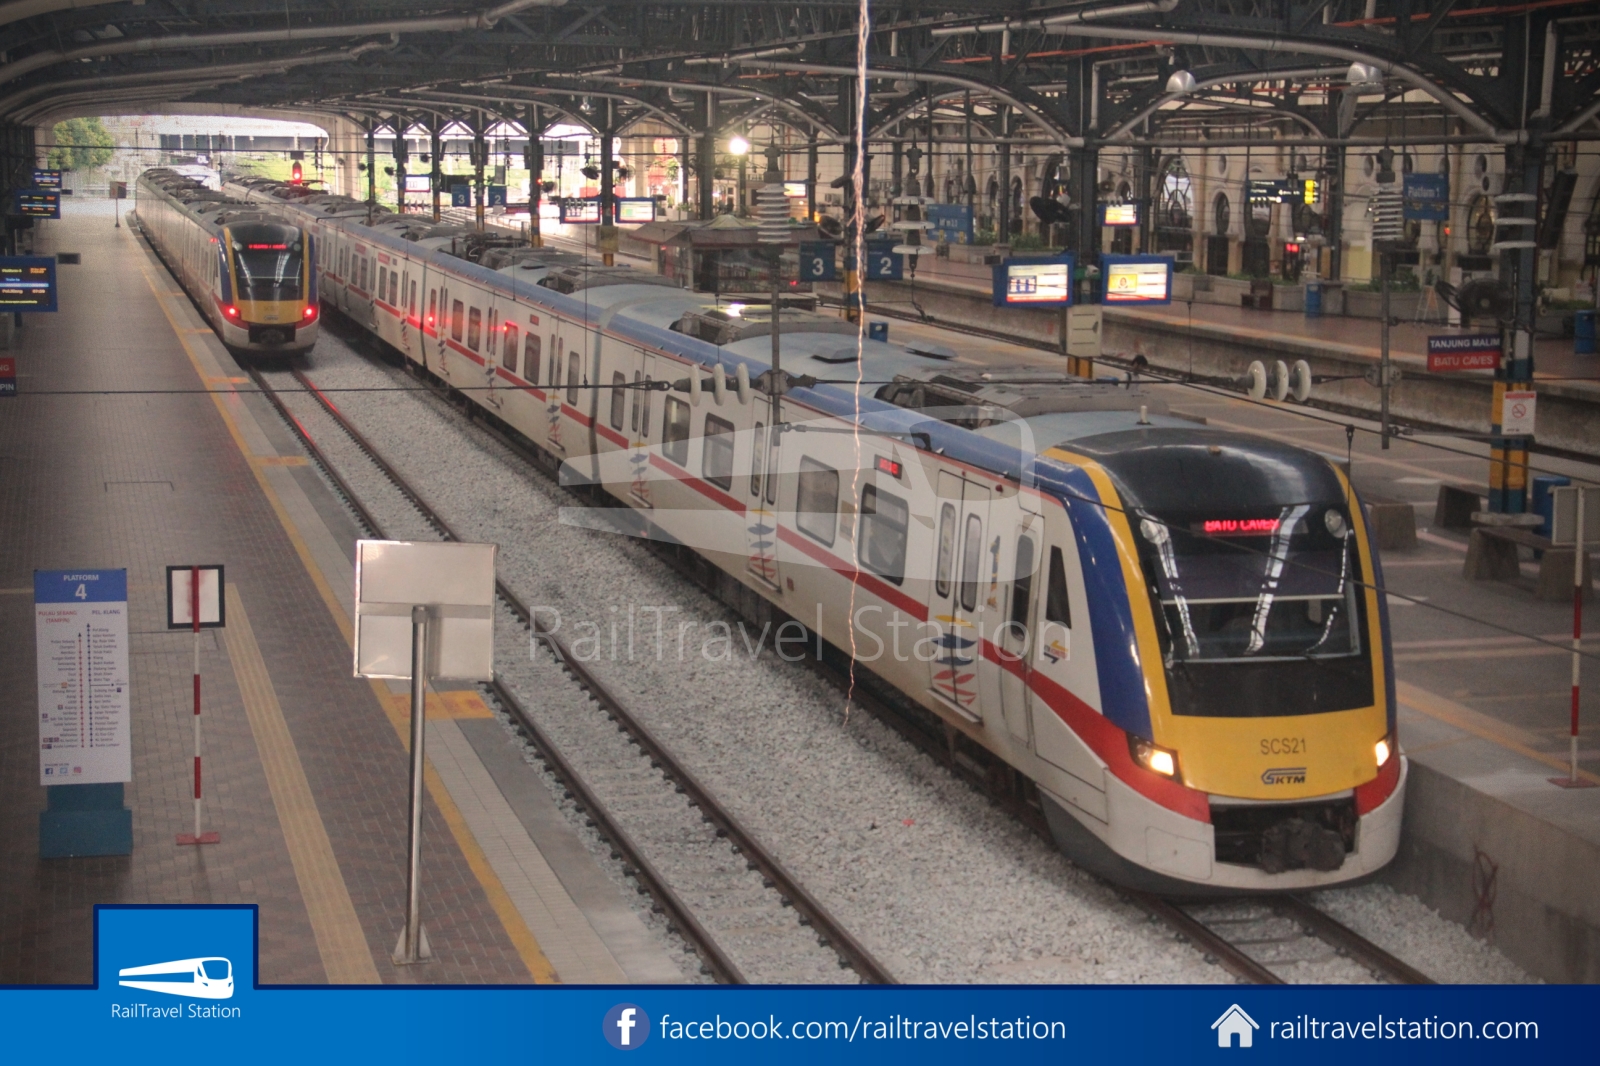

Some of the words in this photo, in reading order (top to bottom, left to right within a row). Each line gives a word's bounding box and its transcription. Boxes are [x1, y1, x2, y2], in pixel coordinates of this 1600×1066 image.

[458, 194, 465, 204] 3
[494, 195, 501, 204] 2
[812, 258, 824, 276] 3
[880, 257, 892, 275] 2
[1430, 339, 1470, 348] TANJUNG
[1472, 339, 1501, 347] MALIM
[1434, 357, 1459, 366] BATU
[1462, 356, 1493, 366] CAVES
[75, 583, 87, 600] 4
[1260, 737, 1306, 755] SCS21
